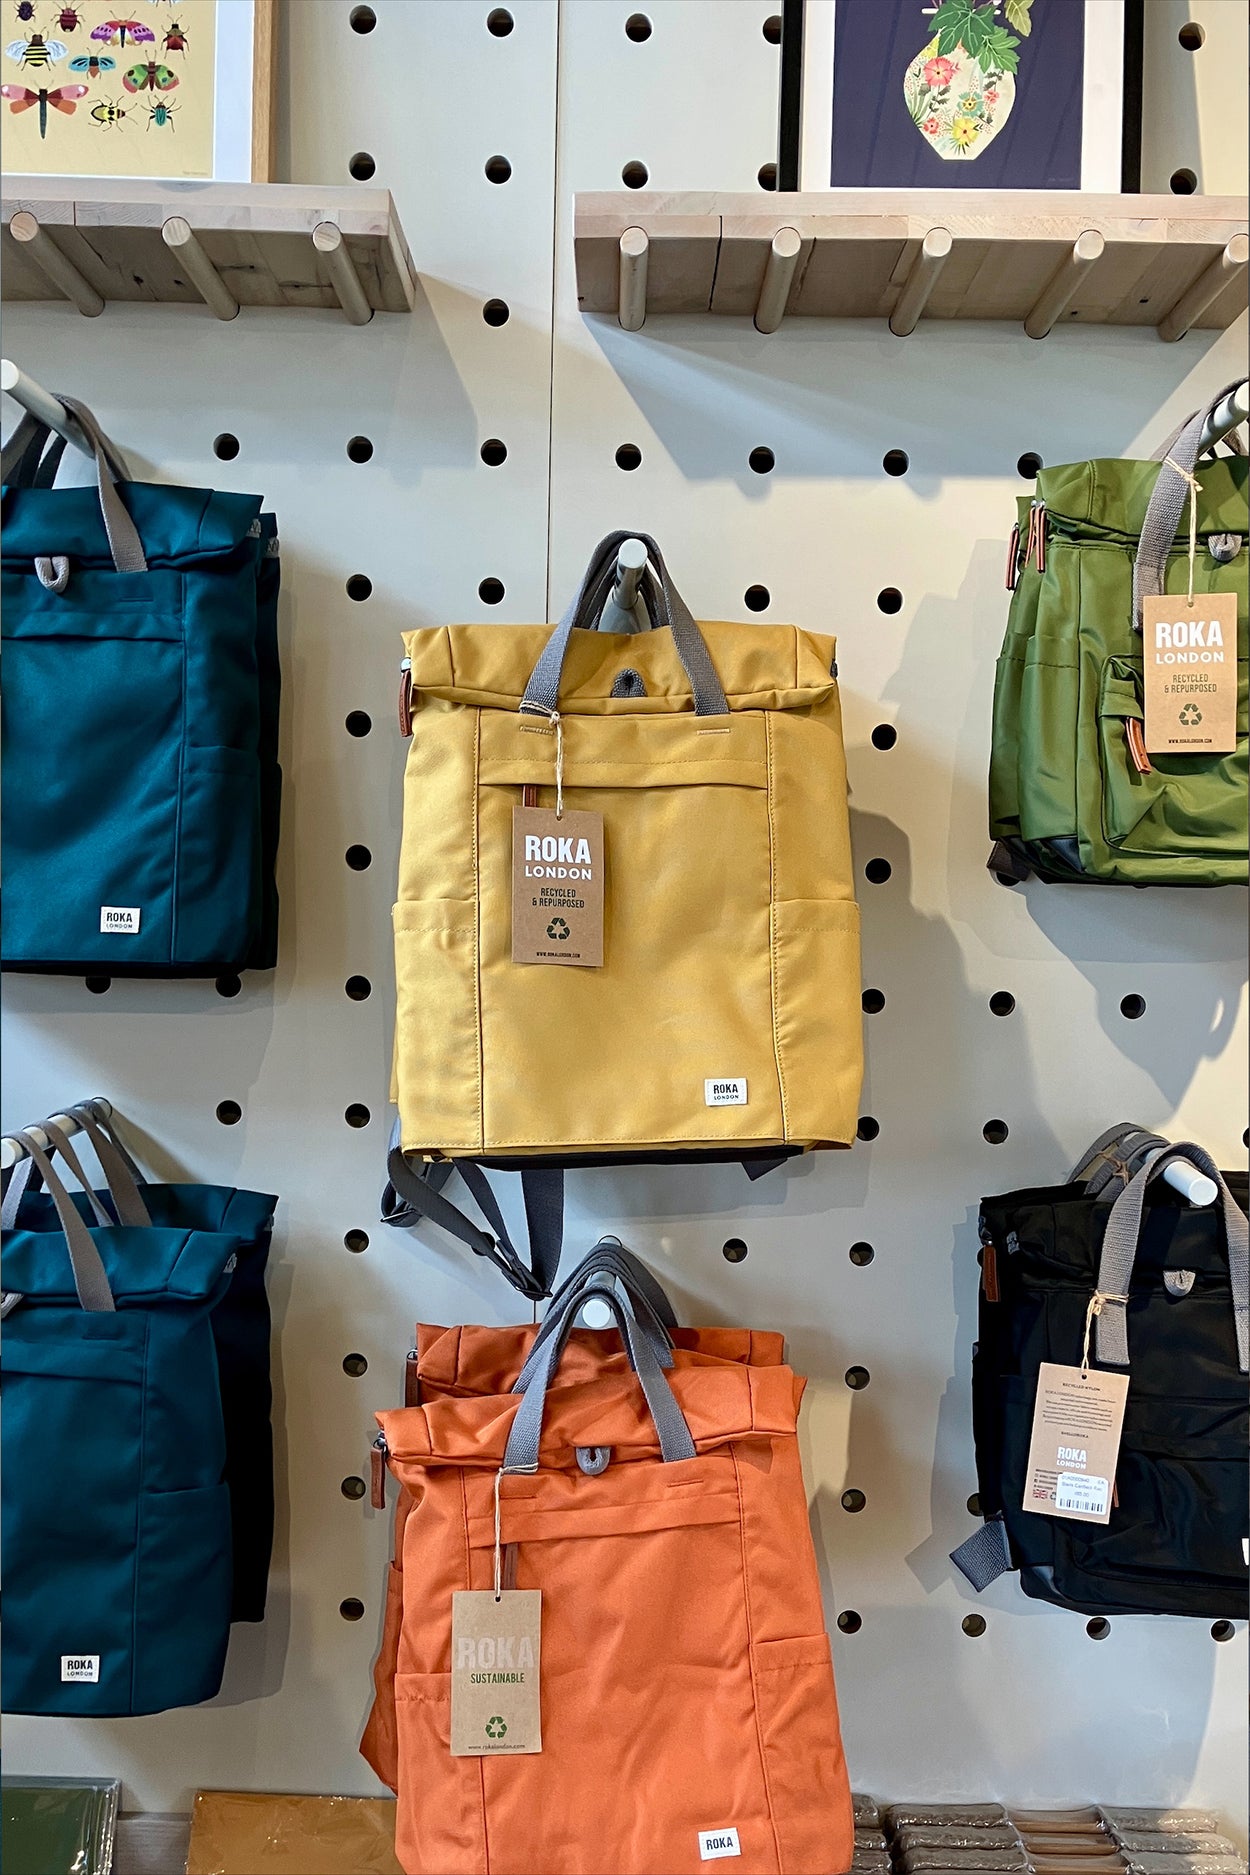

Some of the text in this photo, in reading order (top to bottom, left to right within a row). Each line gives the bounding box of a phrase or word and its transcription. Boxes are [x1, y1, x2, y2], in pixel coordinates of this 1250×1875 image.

[1155, 620, 1223, 649] ROKA
[1156, 651, 1224, 665] LONDON
[1173, 673, 1209, 683] RECYCLED
[1164, 683, 1217, 693] & REPURPOSED
[524, 835, 592, 865] ROKA
[525, 865, 592, 880] LONDON
[540, 887, 576, 898] RECYCLED
[532, 897, 585, 908] & REPURPOSED
[106, 912, 132, 922] ROKA
[713, 1083, 738, 1094] ROKA
[1057, 1446, 1087, 1462] ROKA
[1056, 1460, 1087, 1469] LONDON
[456, 1635, 535, 1670] ROKA
[67, 1660, 93, 1670] ROKA
[470, 1672, 525, 1684] SUSTAINABLE
[706, 1836, 733, 1850] ROKA
